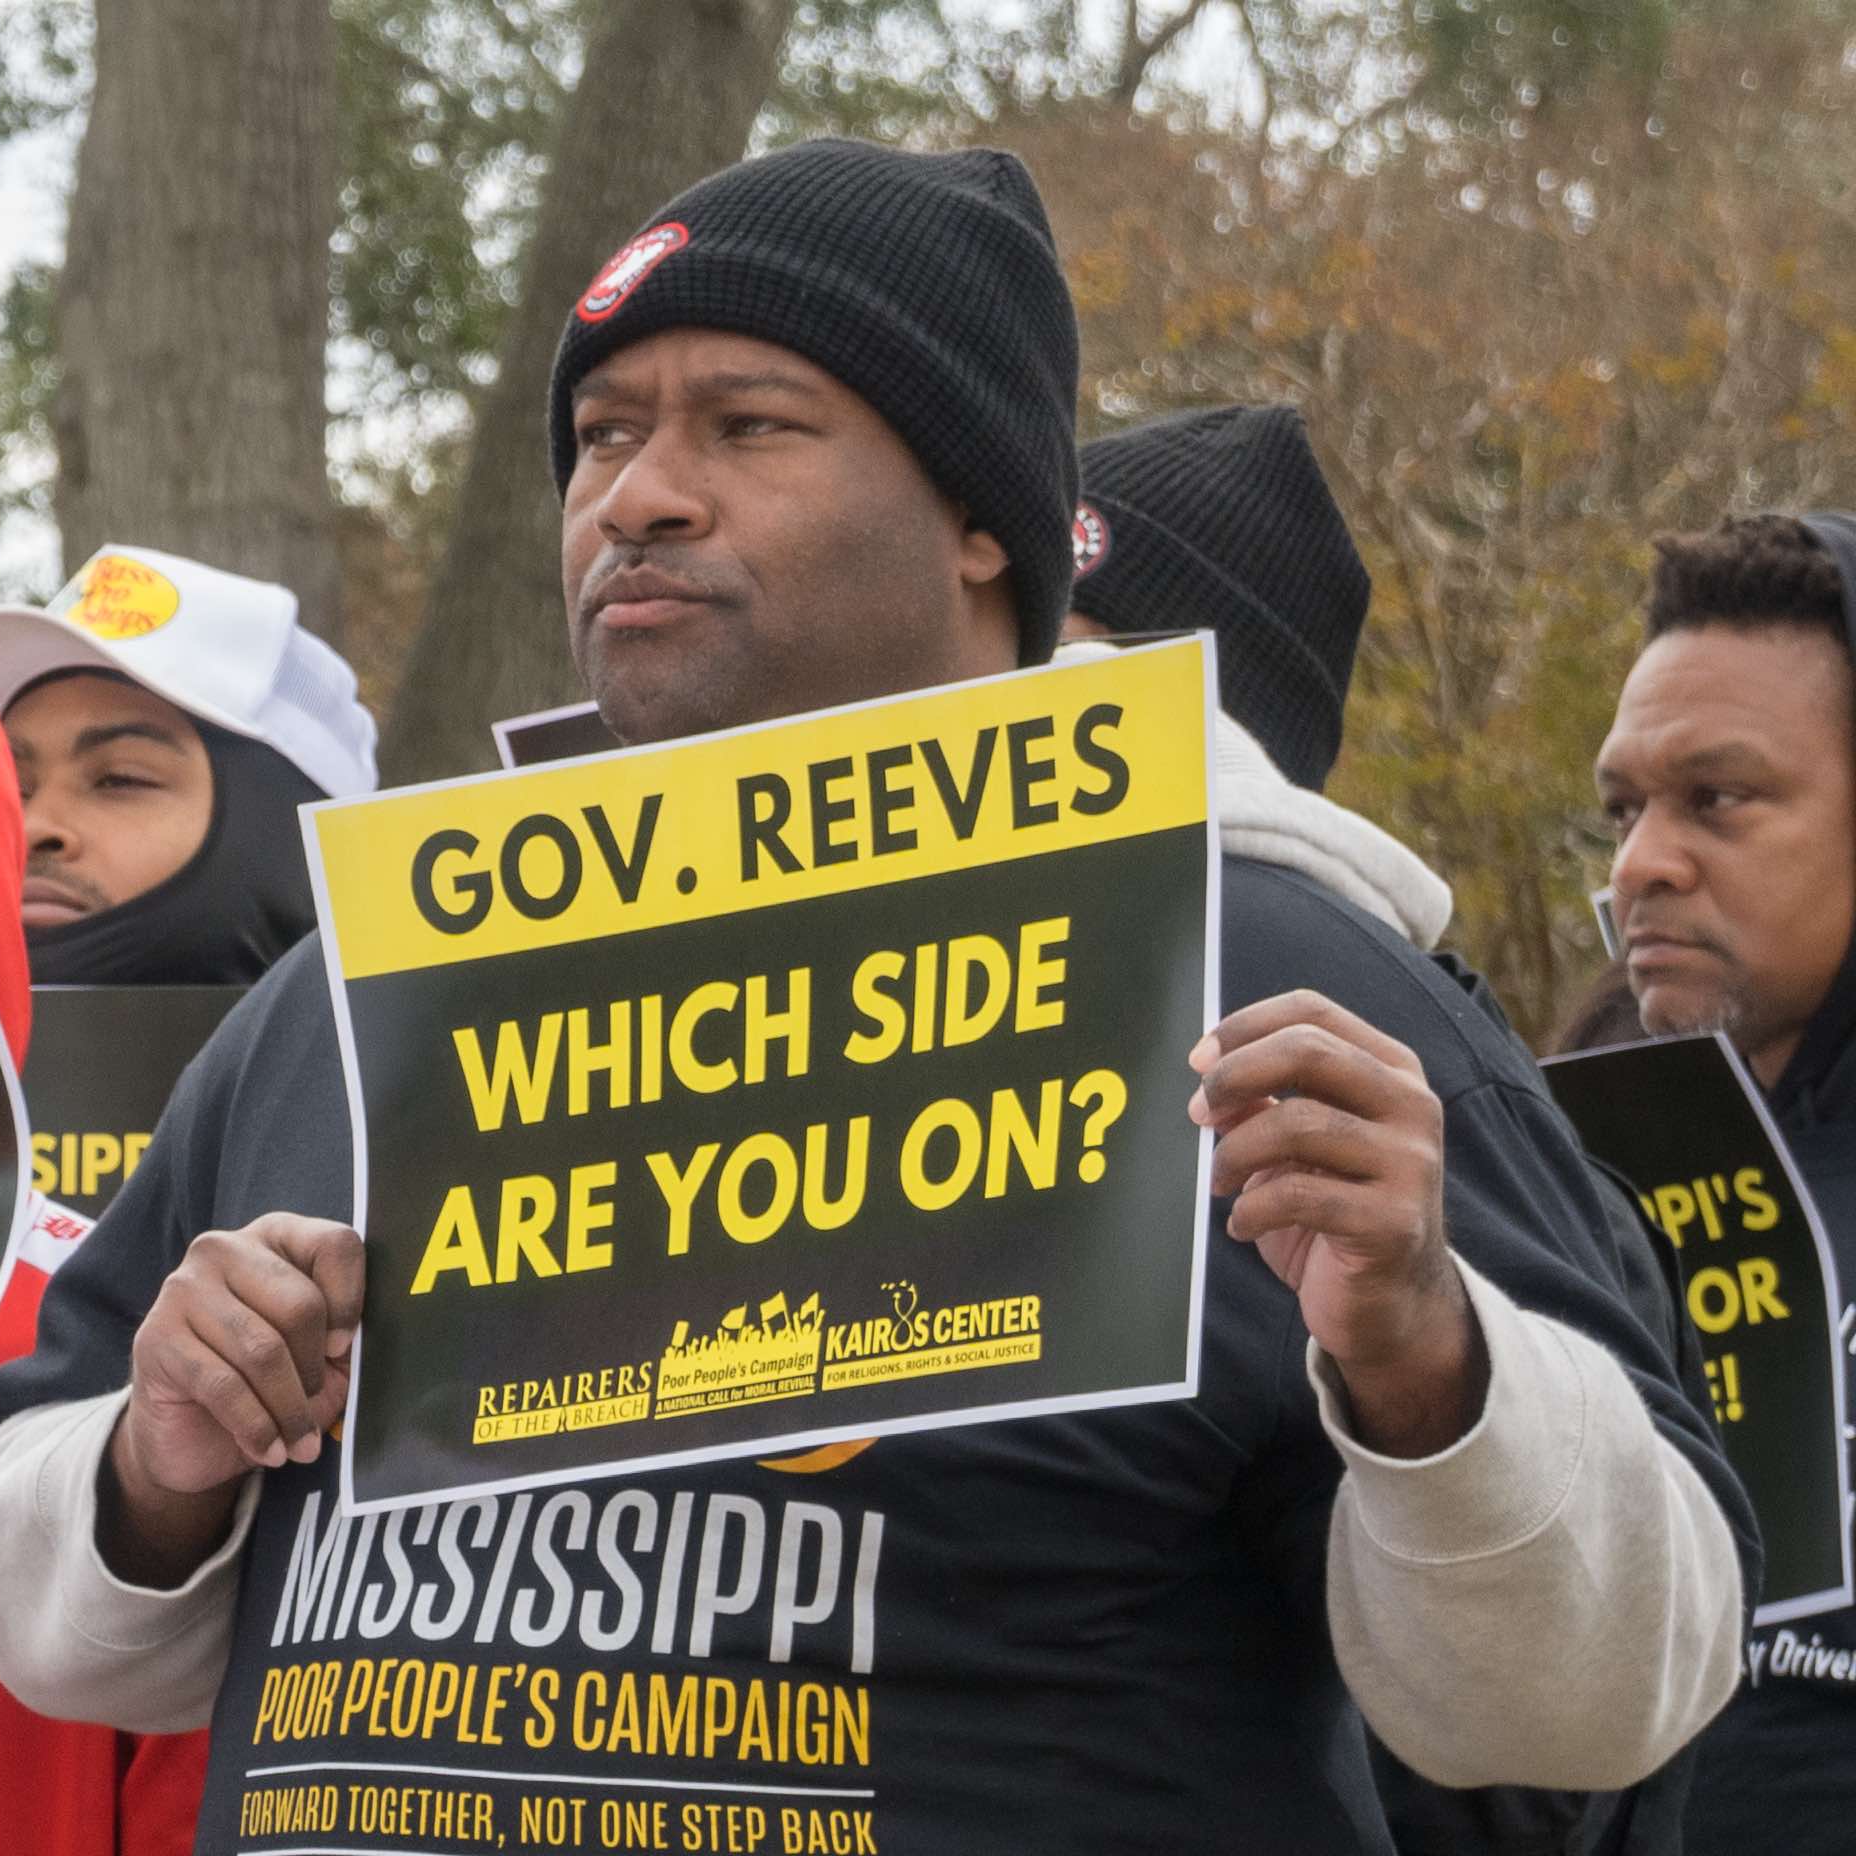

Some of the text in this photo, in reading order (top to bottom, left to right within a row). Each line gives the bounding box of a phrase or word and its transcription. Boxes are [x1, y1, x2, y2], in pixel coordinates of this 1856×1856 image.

[408, 703, 1132, 937] GOV. REEVES
[452, 916, 1072, 1133] WHICH SIDE
[409, 1069, 1130, 1295] ARE YOU ON?
[933, 1296, 1041, 1344] CENTER
[478, 1360, 652, 1418] REPAIRERS
[662, 1352, 814, 1392] Poor People's Campaign
[663, 1394, 706, 1413] NATIONAL
[707, 1391, 729, 1407] CALL
[745, 1382, 776, 1400] MORAL
[777, 1374, 815, 1396] REVIVAL
[827, 1343, 1035, 1383] FOR RELIGIONS, RIGHTS & SOCIAL JUSTICE
[477, 1398, 646, 1441] OF THE BREACH
[270, 1489, 885, 1673] MISSISSIPPI
[253, 1659, 870, 1766] POOR PEOPLE'S CAMPAIGN
[240, 1786, 878, 1856] FORWARD TOGETHER, NOT ONE STEP BACK
